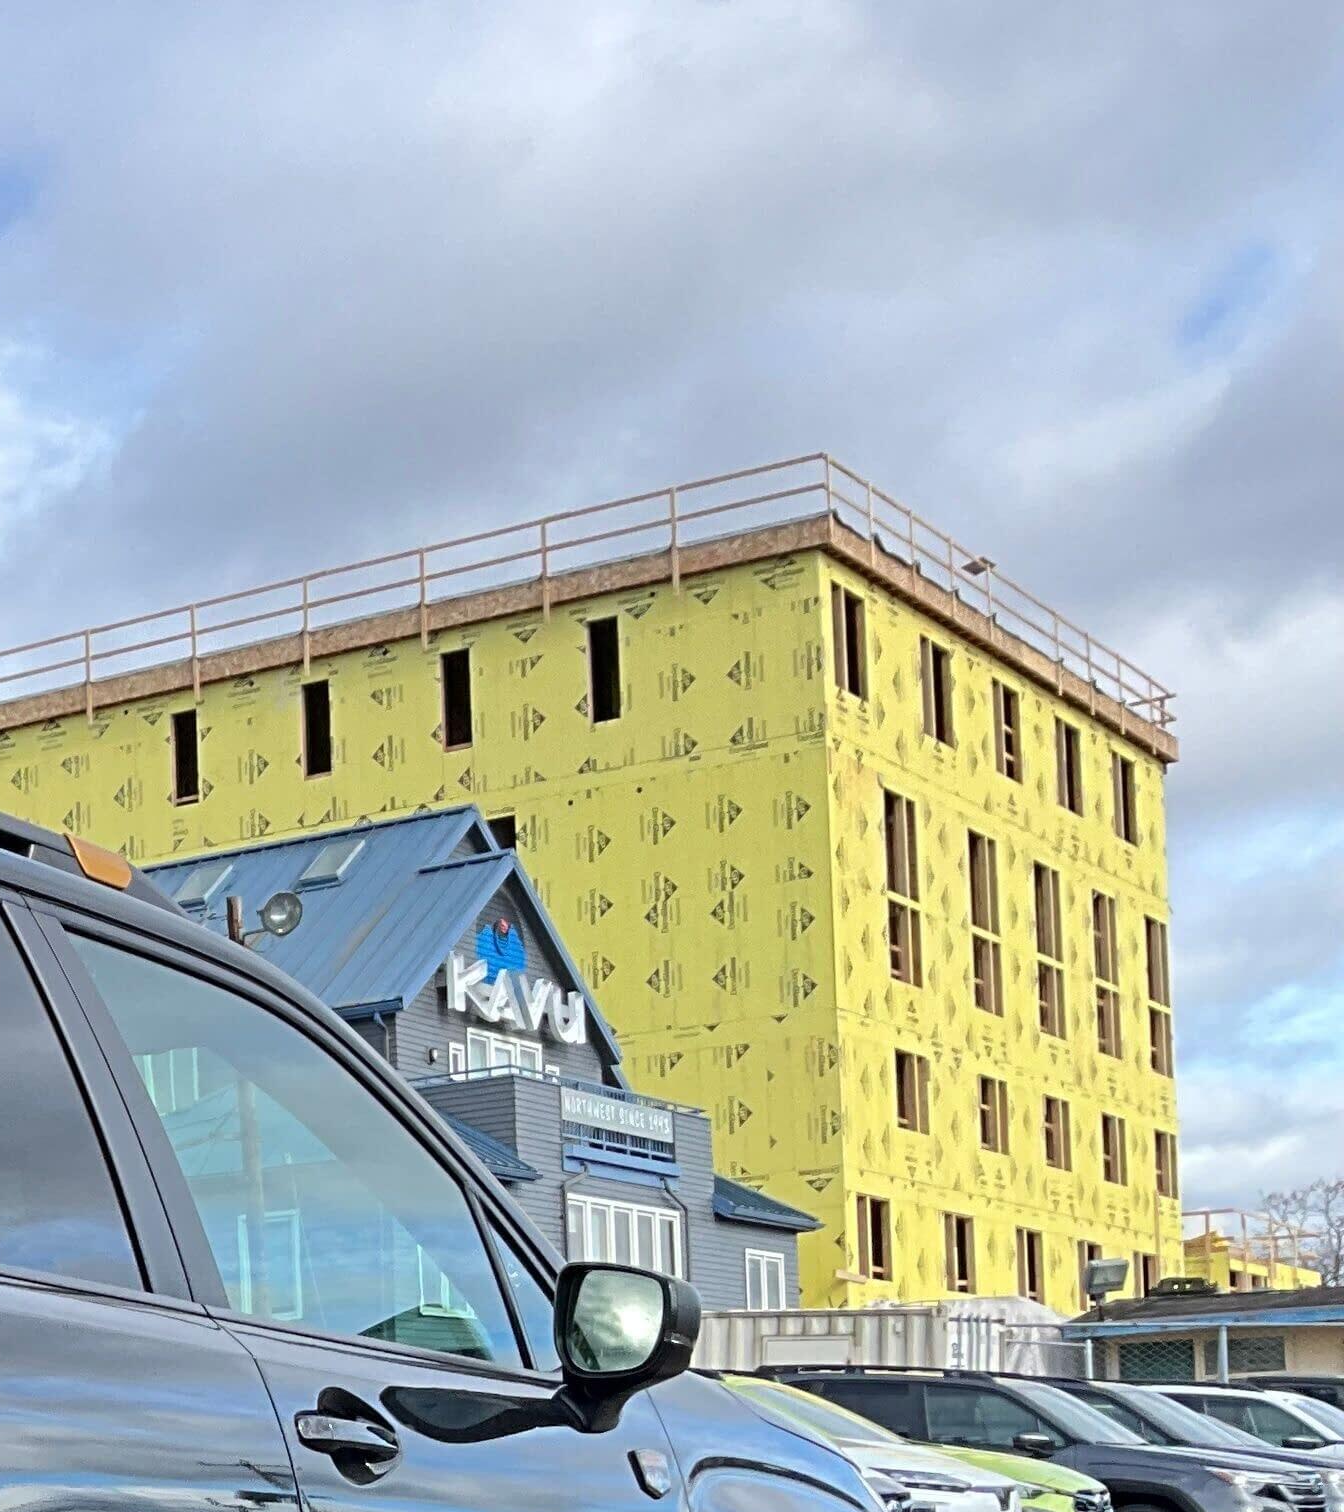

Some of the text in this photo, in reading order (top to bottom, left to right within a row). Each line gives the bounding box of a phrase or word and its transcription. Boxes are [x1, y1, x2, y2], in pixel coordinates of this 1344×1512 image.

[446, 950, 587, 1044] KAVU
[564, 1095, 615, 1121] NORTHWEST
[619, 1106, 645, 1129] SINCE
